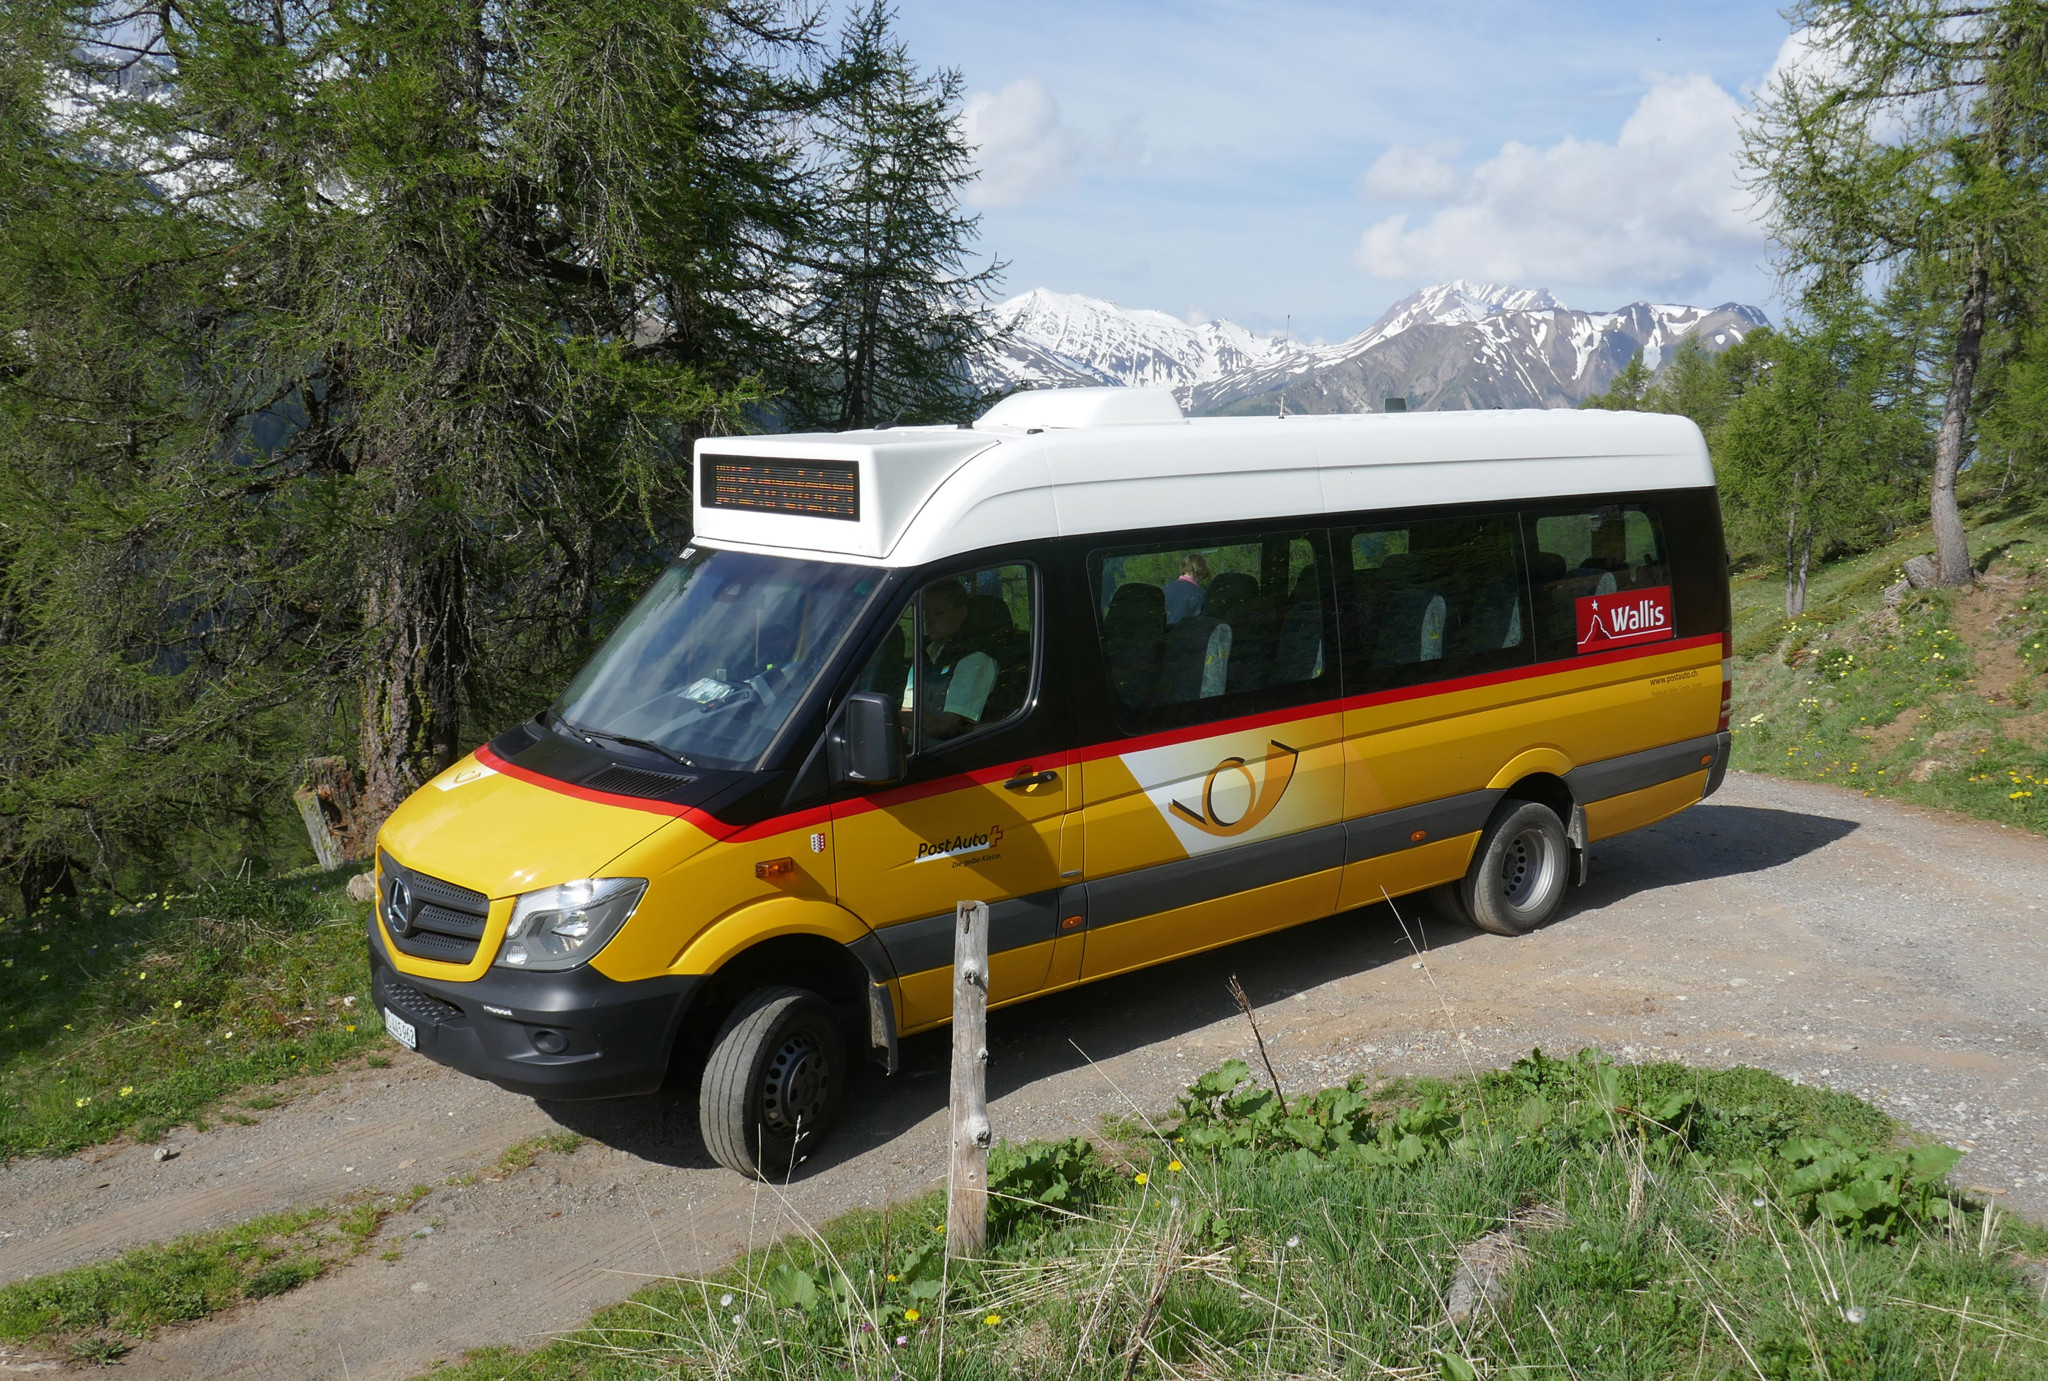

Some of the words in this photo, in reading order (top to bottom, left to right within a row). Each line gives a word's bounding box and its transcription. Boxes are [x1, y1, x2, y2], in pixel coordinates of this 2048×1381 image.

[1610, 599, 1665, 633] Wallis
[1650, 669, 1698, 686] www.postauto.ch
[917, 832, 988, 858] PostAuto
[952, 859, 963, 868] Die
[963, 857, 981, 867] gelbe
